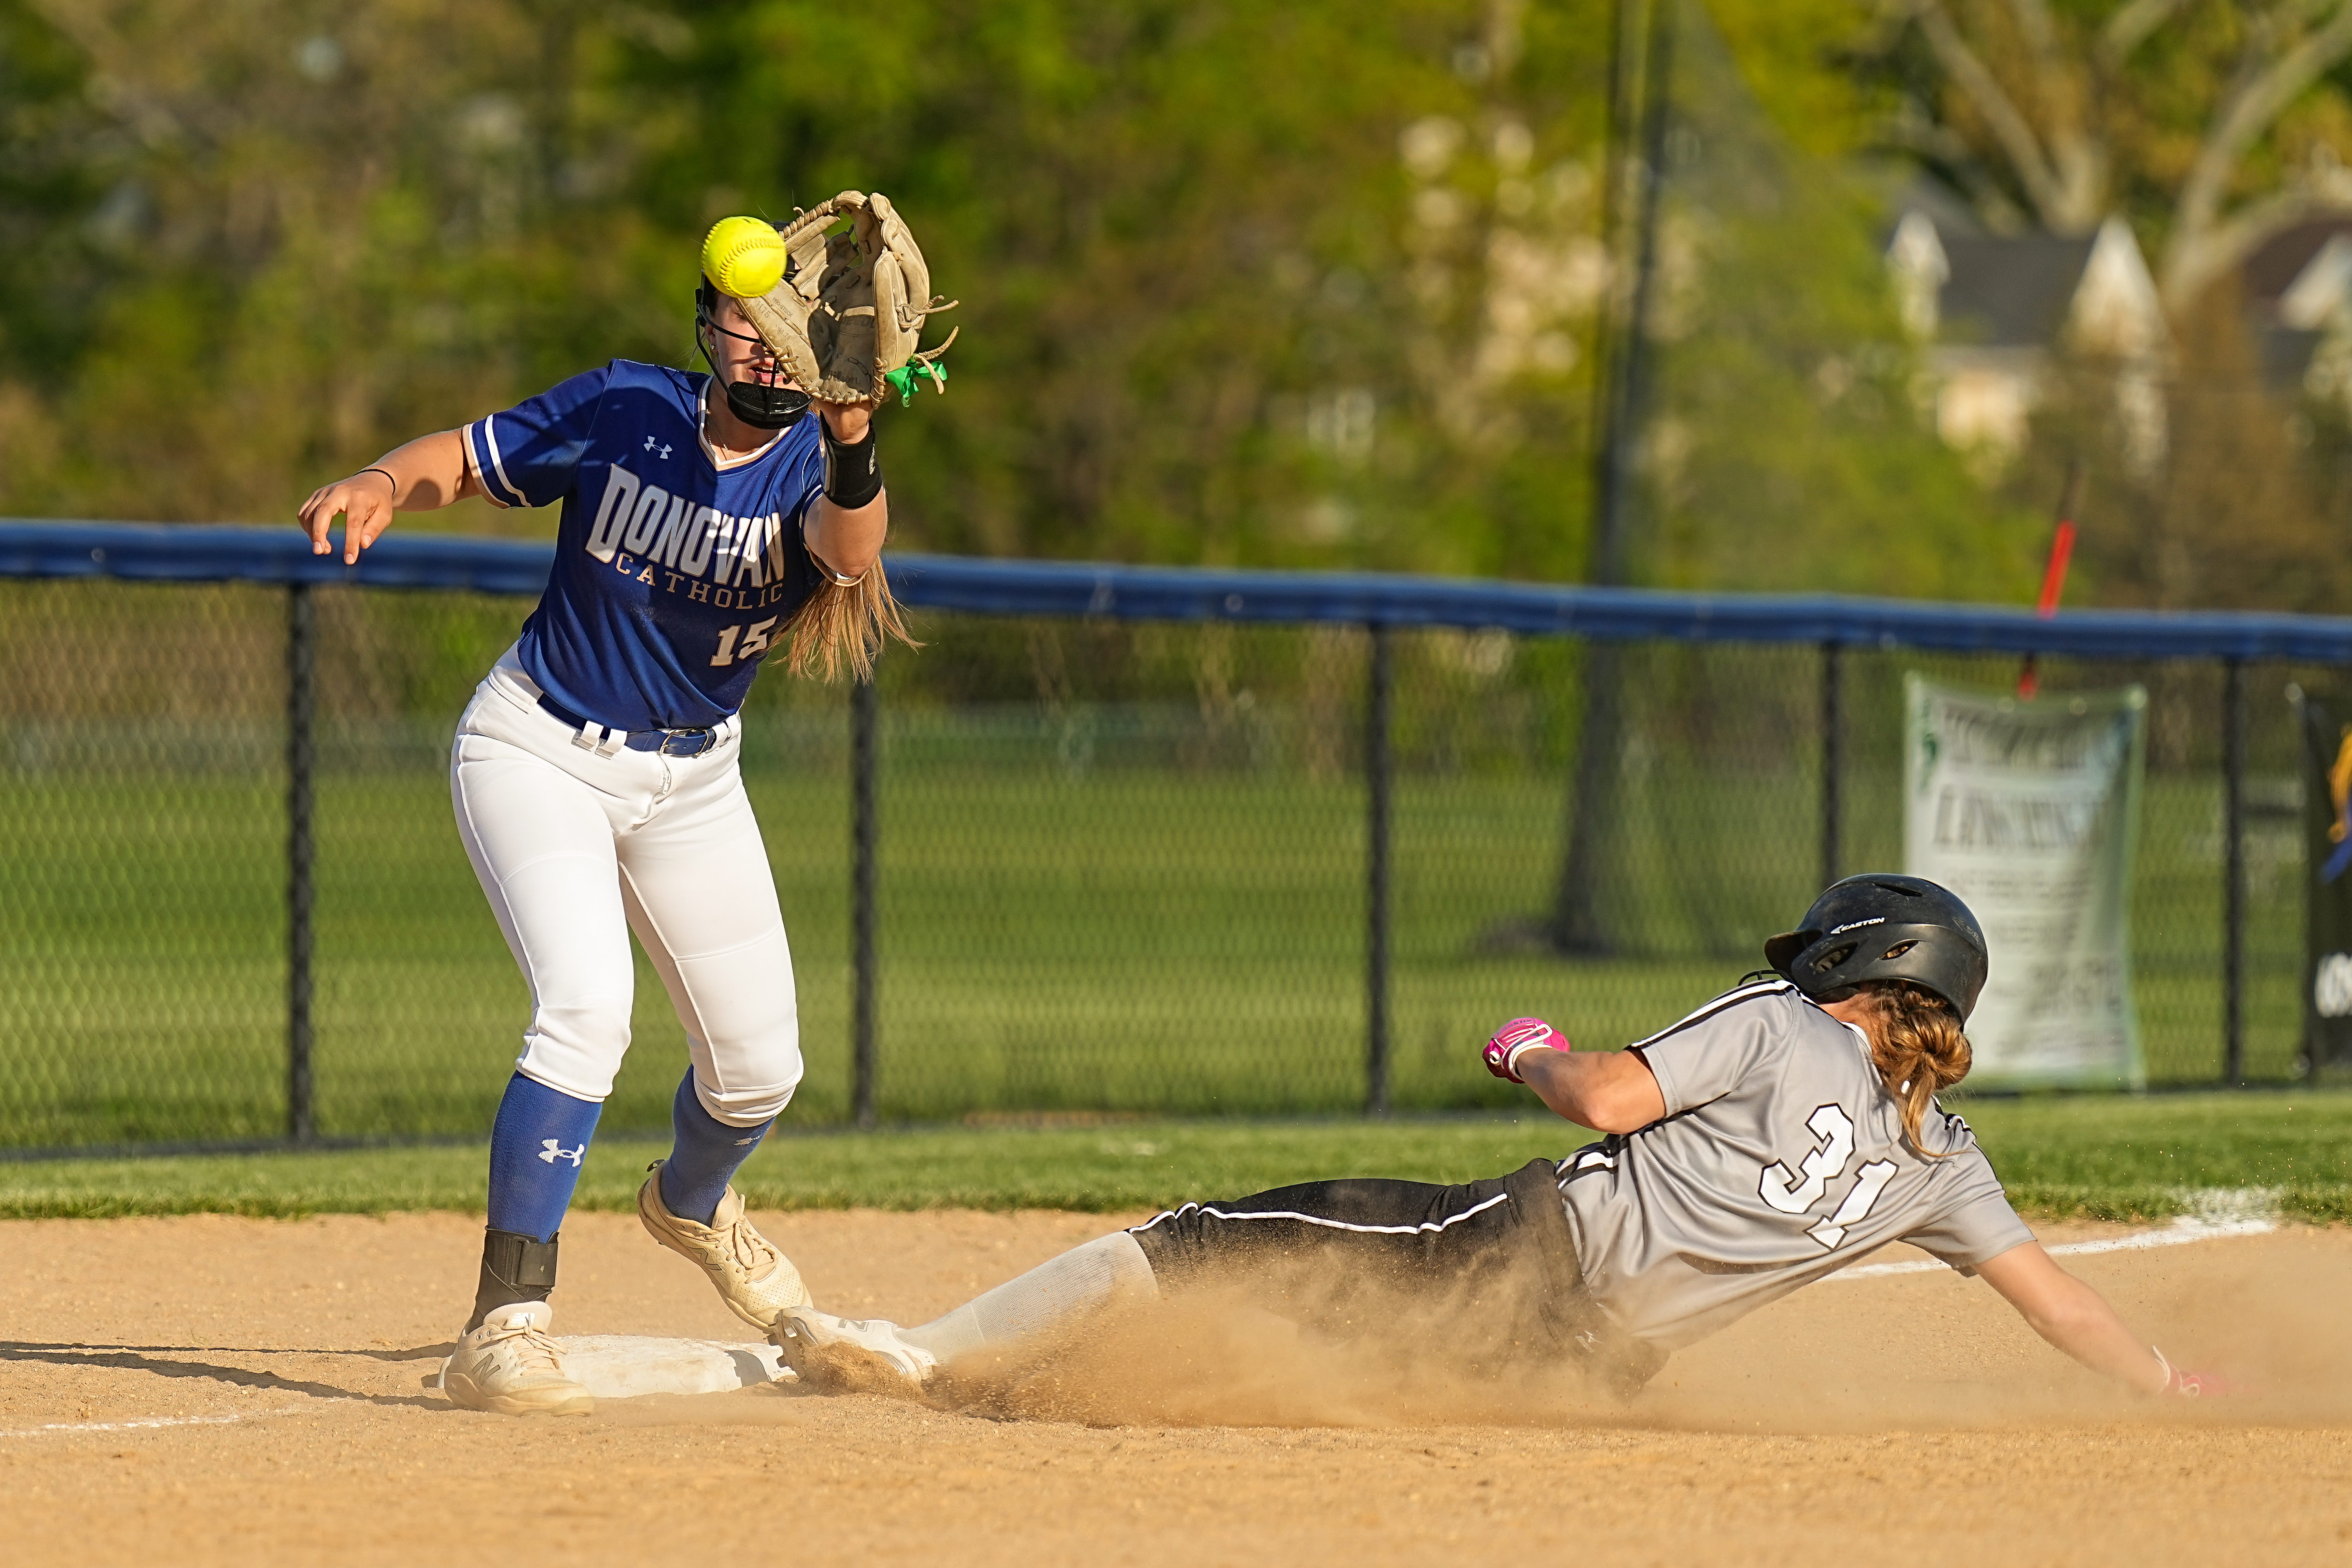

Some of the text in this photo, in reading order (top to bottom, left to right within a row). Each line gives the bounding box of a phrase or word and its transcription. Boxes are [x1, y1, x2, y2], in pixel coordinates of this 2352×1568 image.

[585, 463, 784, 588] DONOVAN
[616, 552, 783, 610] CATHOLIC
[709, 614, 778, 666] 15
[1840, 917, 1885, 931] EASTON
[1758, 1102, 1899, 1252] 31
